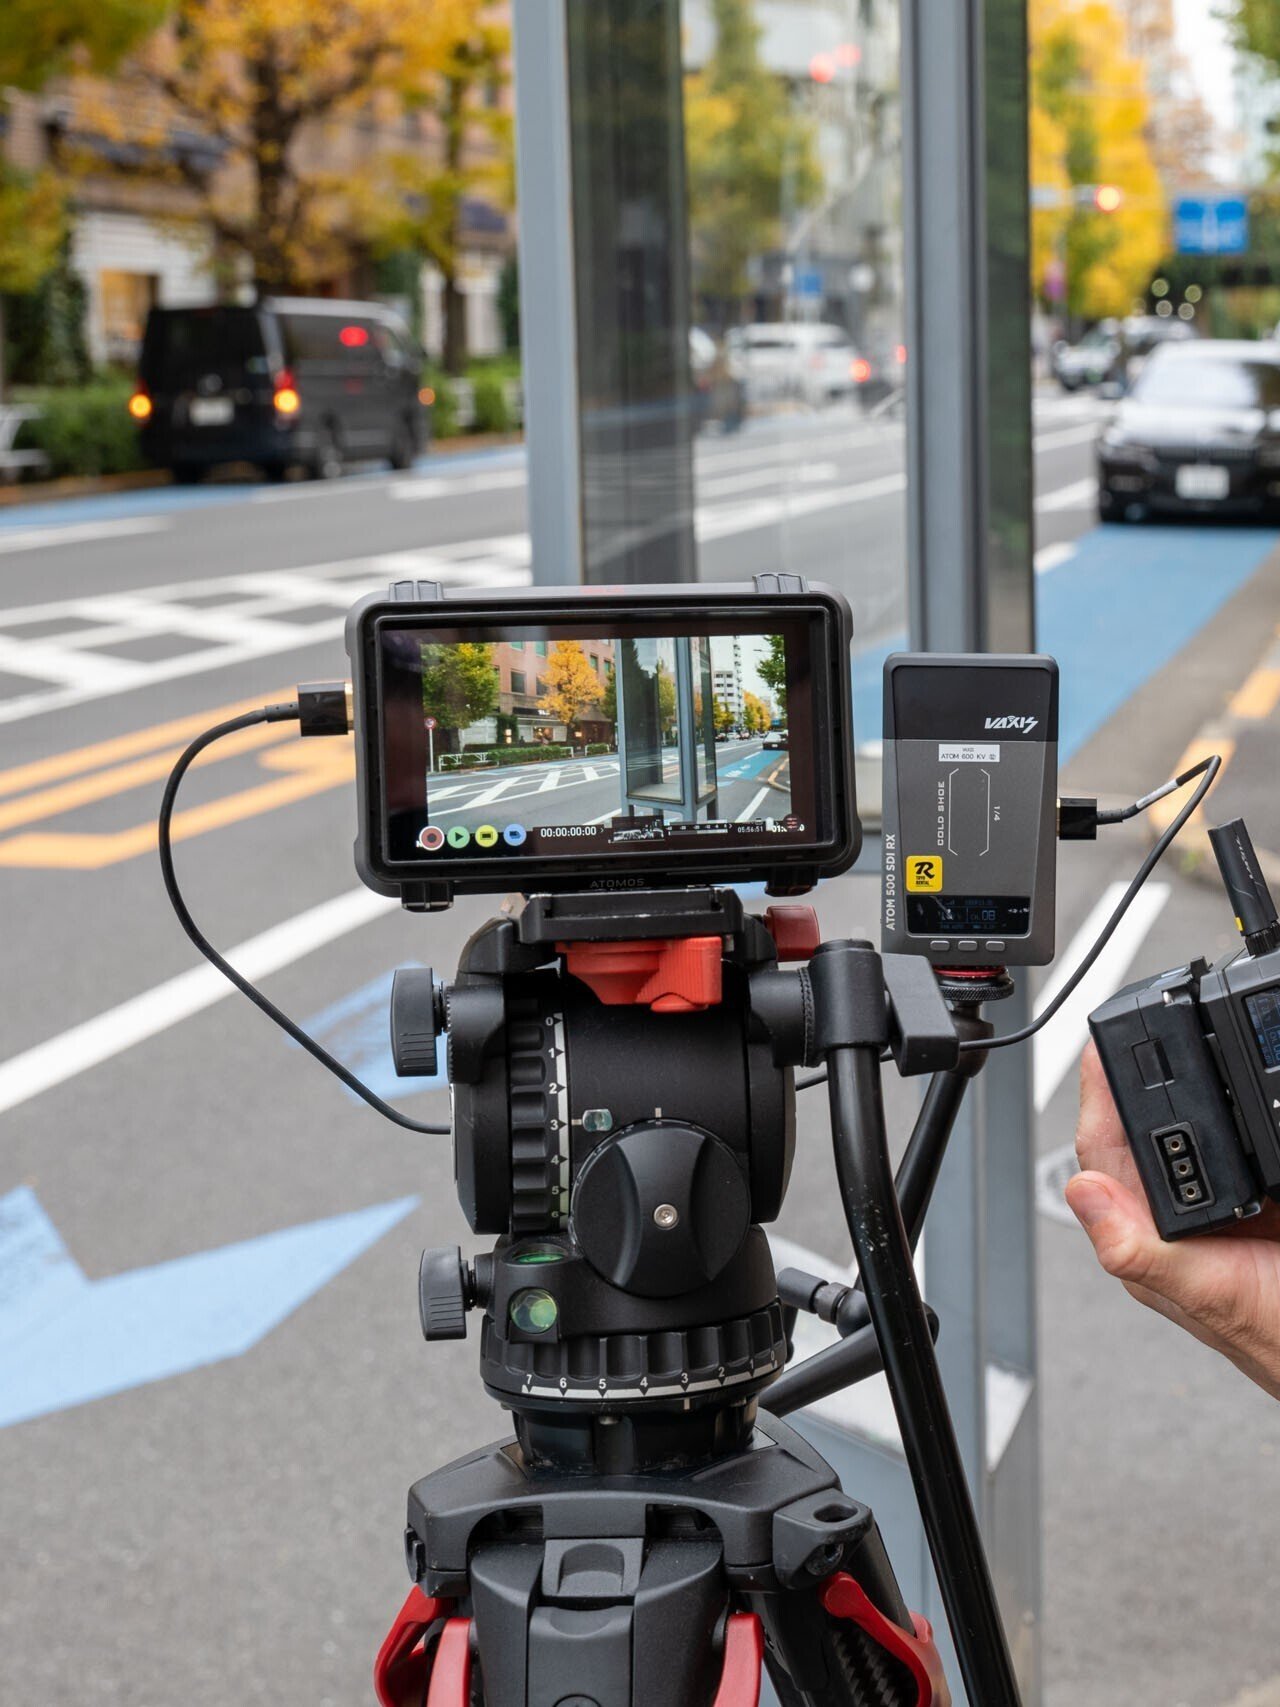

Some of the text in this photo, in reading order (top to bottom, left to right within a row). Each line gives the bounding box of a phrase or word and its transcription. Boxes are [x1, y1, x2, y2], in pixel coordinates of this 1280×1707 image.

[984, 715, 1039, 734] VAXIS
[937, 781, 945, 812] SHOE
[993, 805, 1001, 821] 1/4
[540, 826, 597, 838] 00:00:00:00
[590, 878, 646, 890] ATOMOS
[885, 833, 896, 931] ATOM 500 SDI RX
[545, 1016, 554, 1027] 0
[549, 1047, 556, 1059] 1
[549, 1082, 558, 1095] 2
[550, 1118, 559, 1132] 3
[550, 1153, 560, 1165] 4
[551, 1184, 560, 1196] 5
[526, 1373, 533, 1386] 7
[559, 1377, 567, 1389] 6
[598, 1378, 607, 1390] 5
[640, 1376, 649, 1389] 4
[680, 1372, 689, 1384] 3
[717, 1366, 725, 1378] 2
